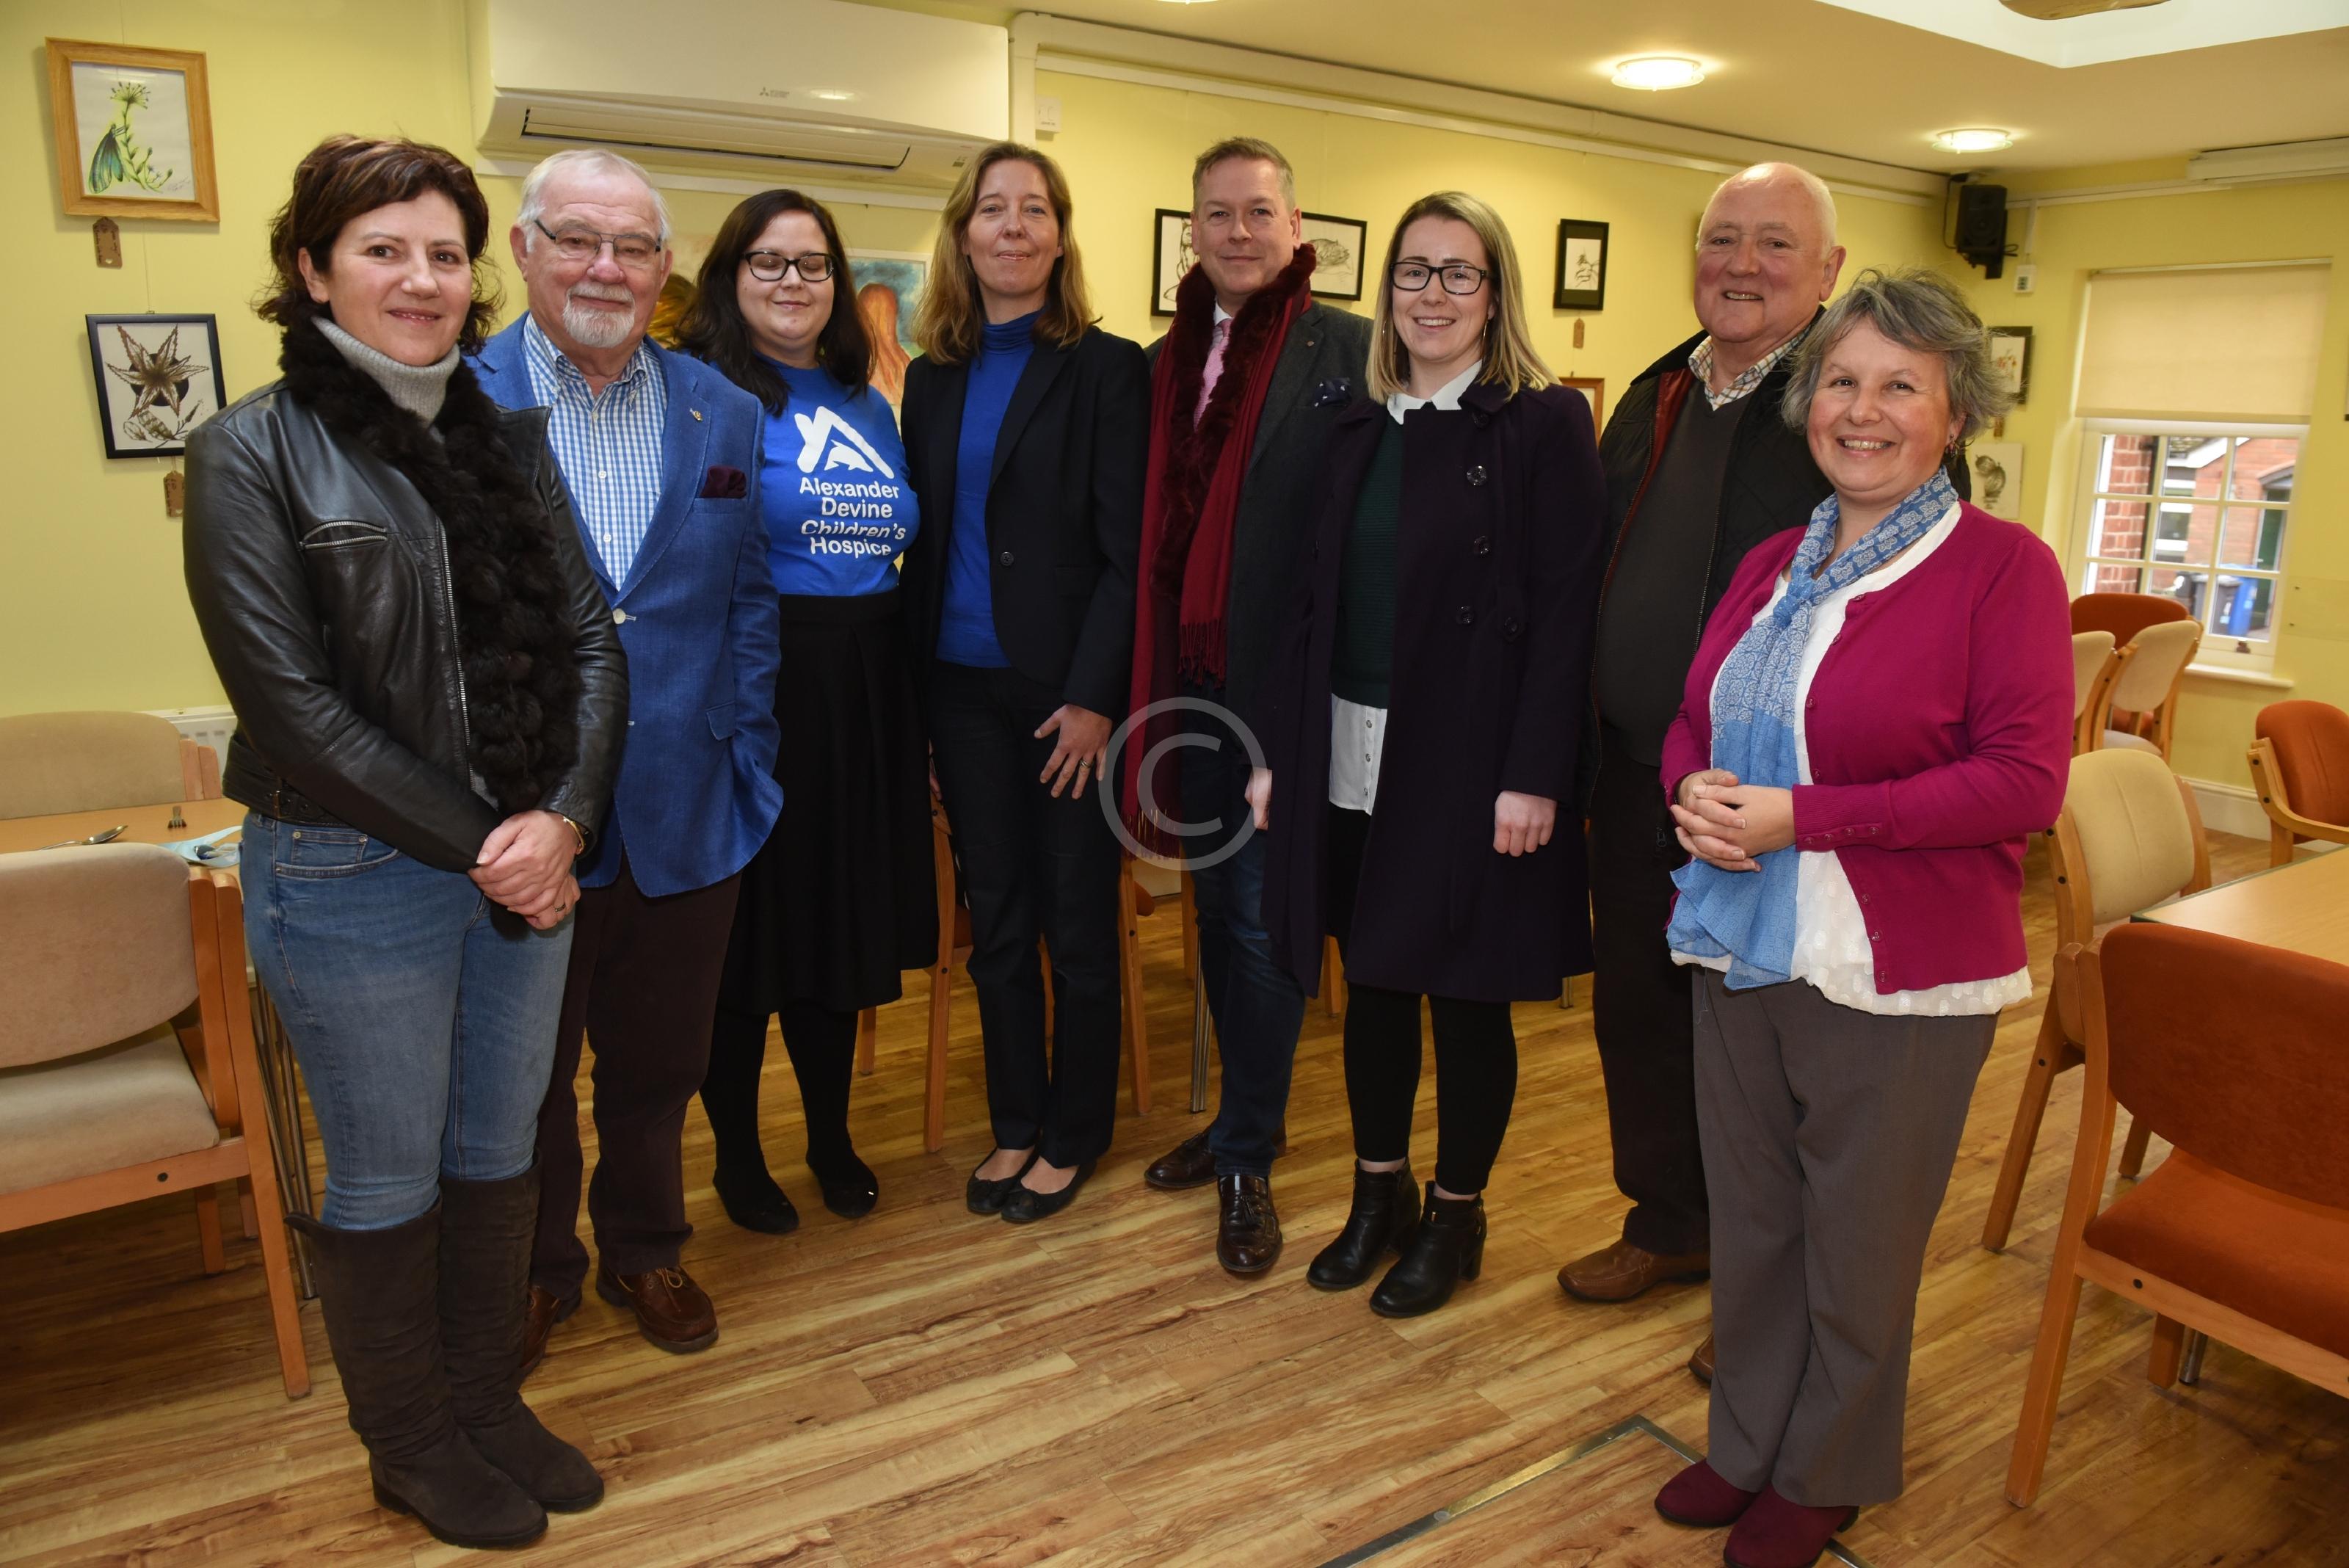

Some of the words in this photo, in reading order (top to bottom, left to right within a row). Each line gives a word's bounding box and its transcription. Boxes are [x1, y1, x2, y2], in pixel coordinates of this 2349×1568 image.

[799, 477, 899, 498] Alexander
[821, 497, 893, 518] Devine
[802, 520, 906, 540] Children's
[810, 537, 891, 558] Hospice
